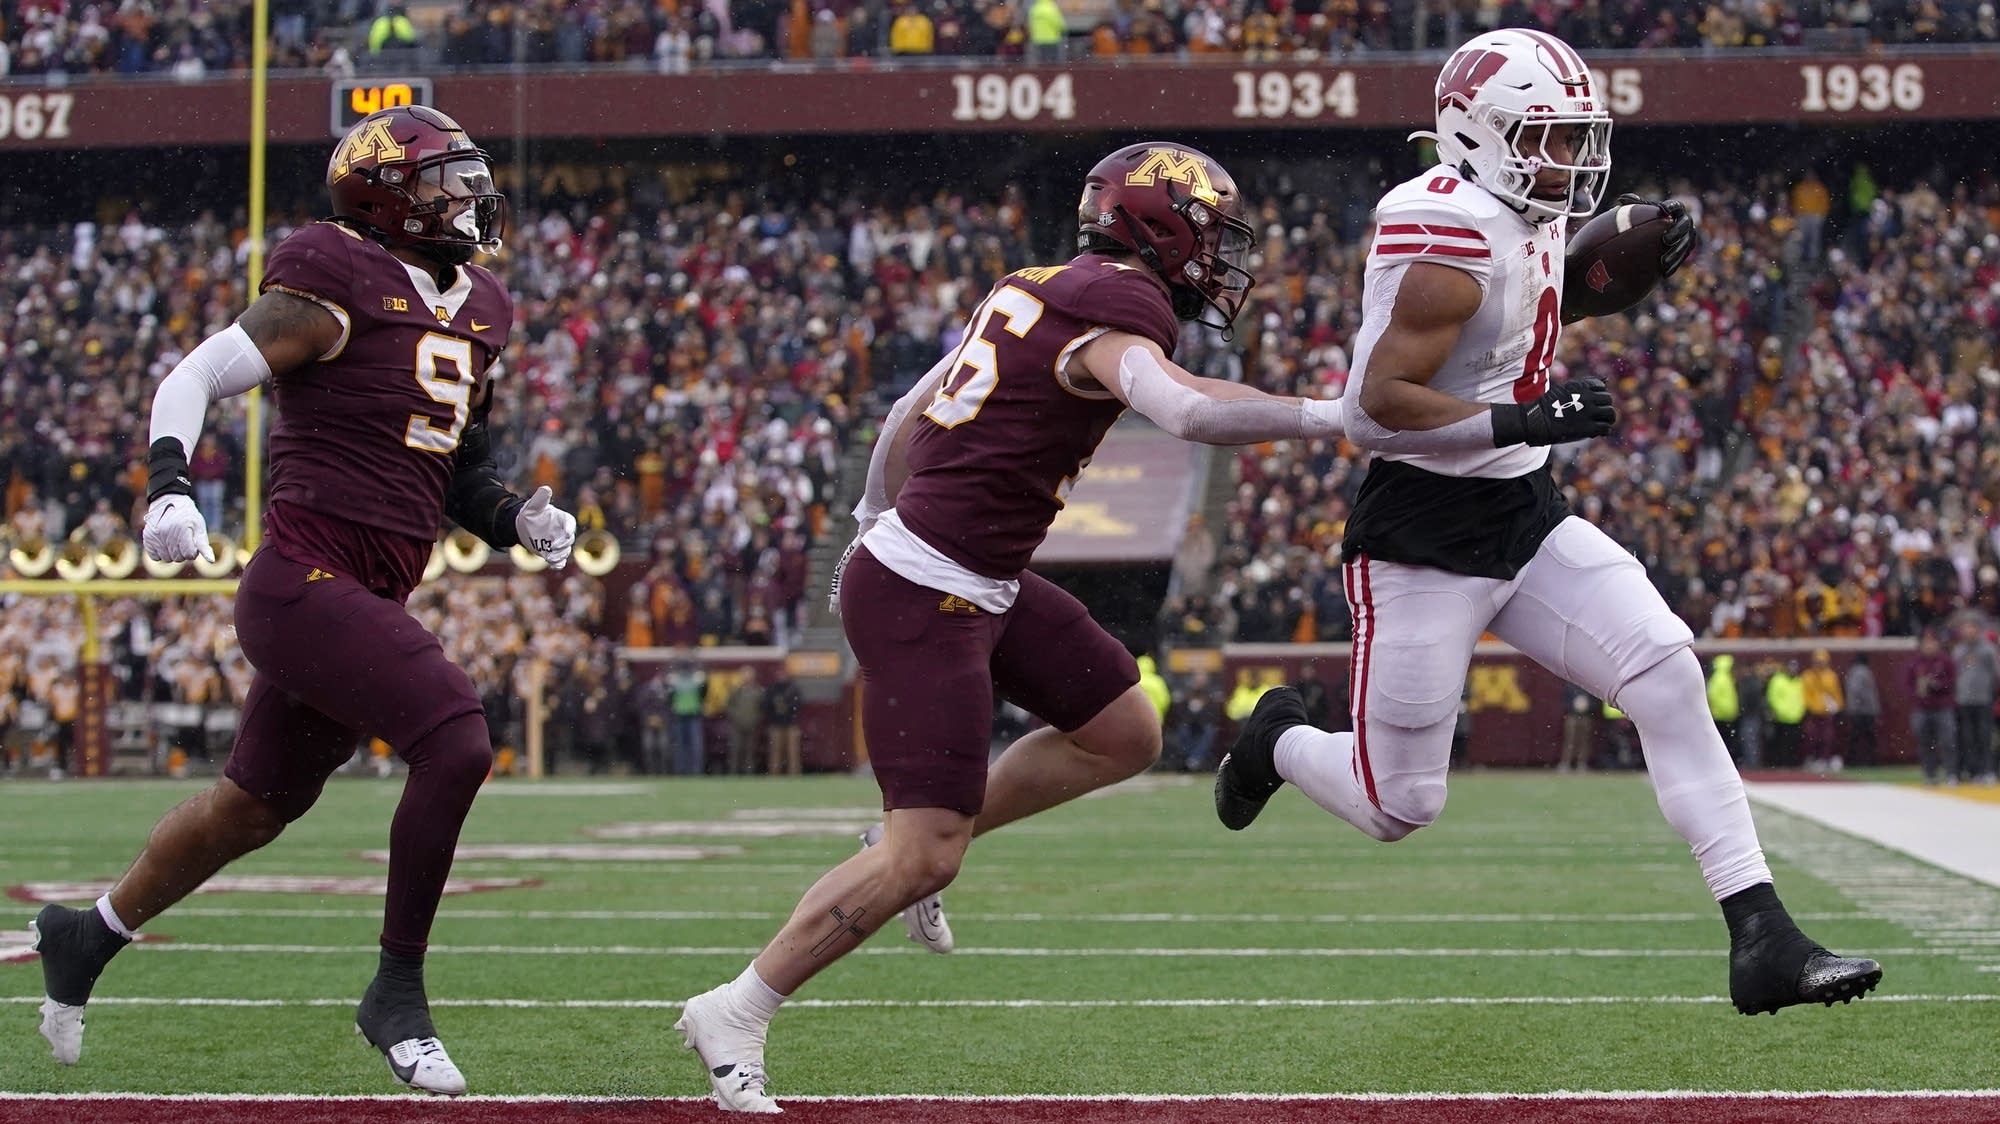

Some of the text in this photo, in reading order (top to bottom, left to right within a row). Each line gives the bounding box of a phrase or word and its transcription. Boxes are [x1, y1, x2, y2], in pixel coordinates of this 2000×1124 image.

[952, 73, 1077, 120] 1904
[1233, 71, 1359, 118] 1934
[1800, 63, 1925, 112] 1936
[333, 116, 405, 184] M
[1125, 147, 1219, 206] M
[1426, 175, 1461, 195] 0
[922, 284, 1045, 430] 6
[1512, 285, 1559, 405] 0
[404, 330, 476, 454] 9
